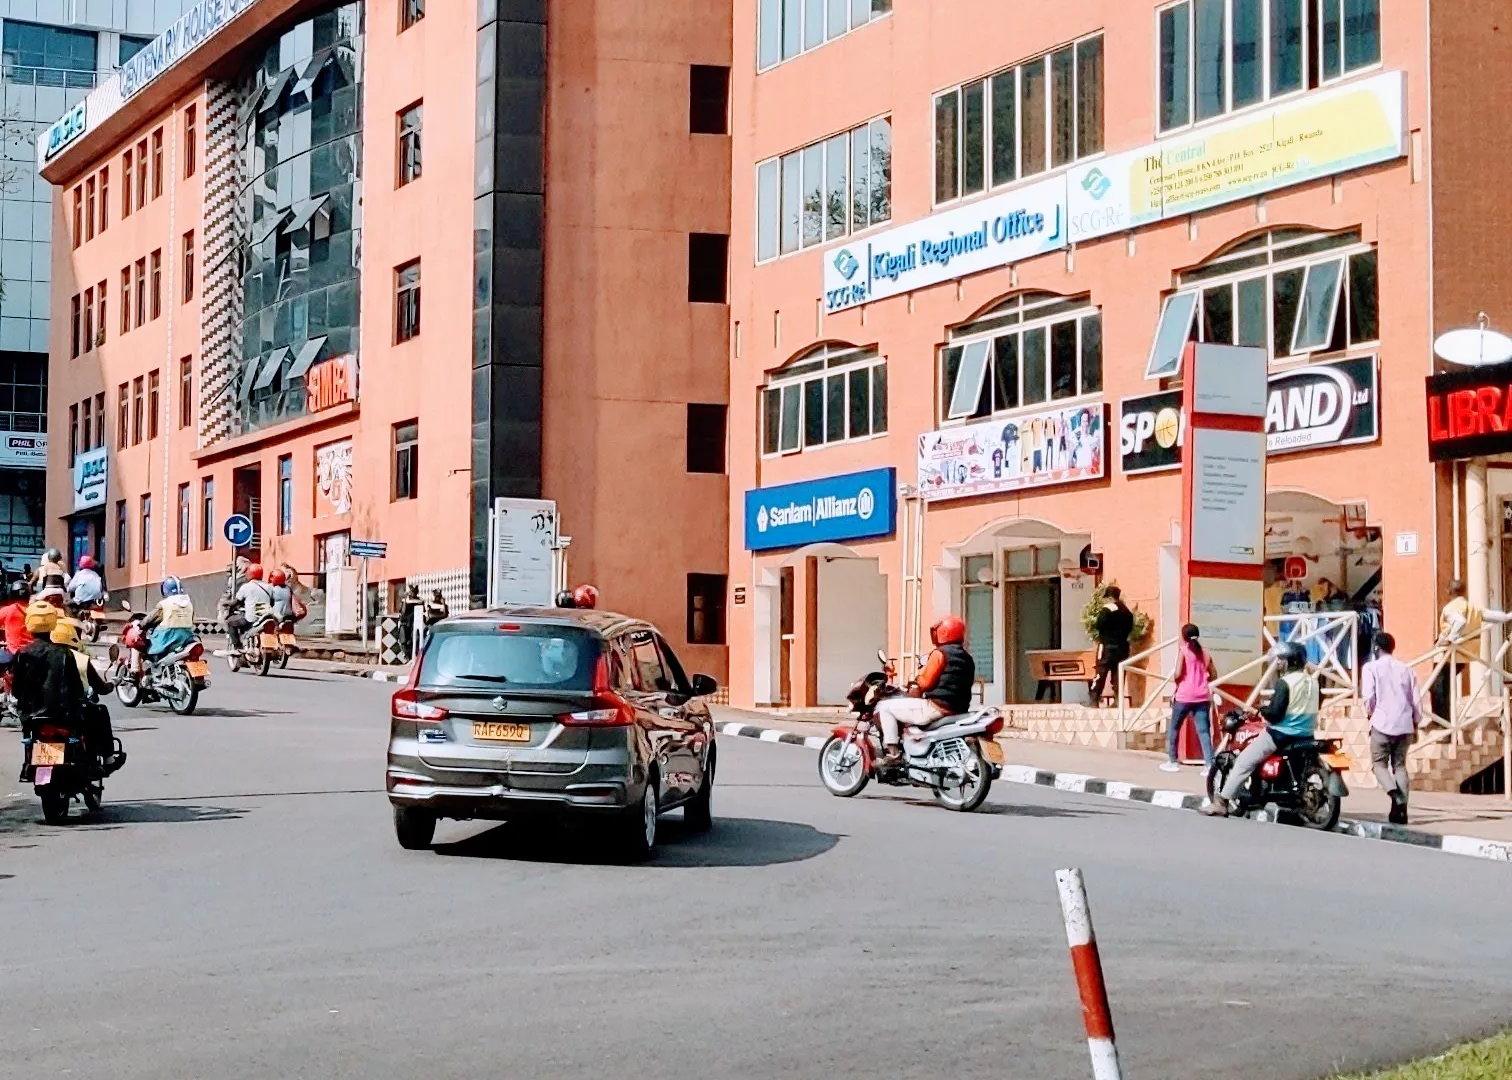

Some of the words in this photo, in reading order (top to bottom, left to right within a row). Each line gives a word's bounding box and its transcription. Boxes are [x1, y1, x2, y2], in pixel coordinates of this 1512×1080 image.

[872, 243, 917, 281] Kigali
[920, 221, 988, 267] Regional
[991, 208, 1045, 244] Office
[307, 356, 351, 412] SIMBA
[1352, 388, 1369, 406] Ltd
[770, 501, 812, 527] Sanlam
[815, 495, 857, 520] Allianz
